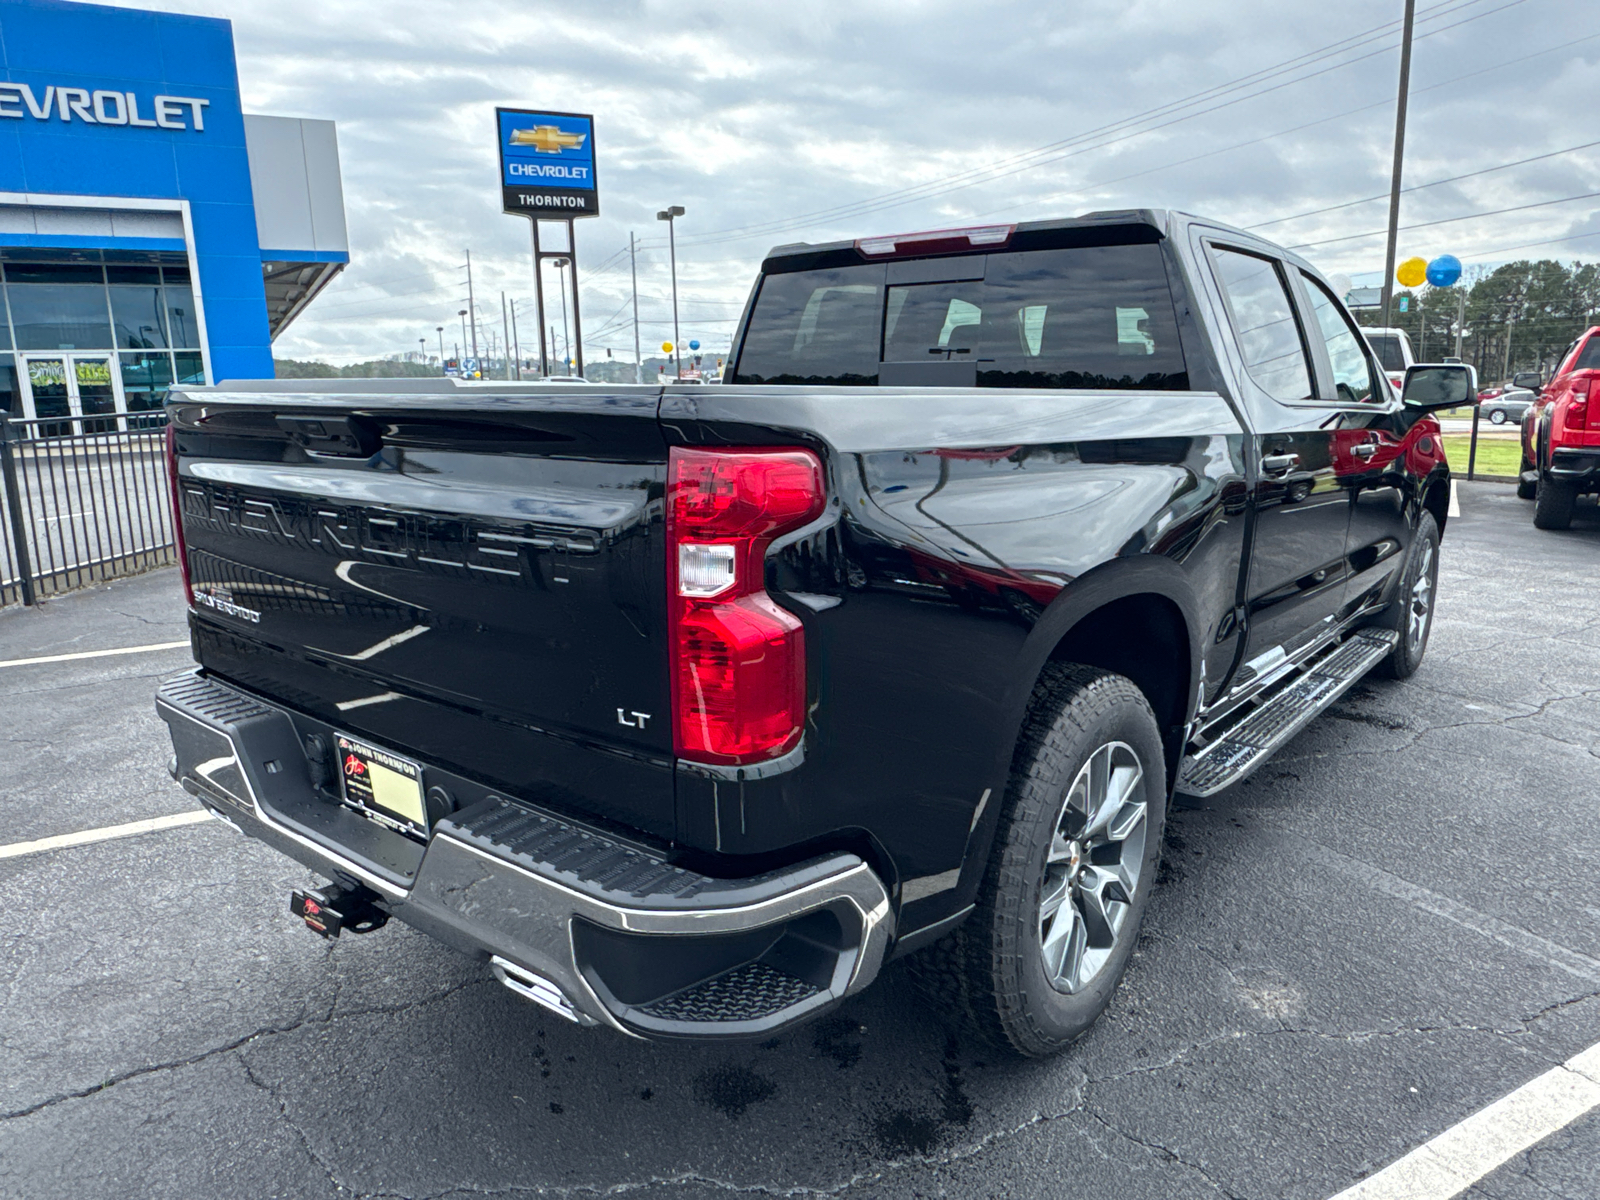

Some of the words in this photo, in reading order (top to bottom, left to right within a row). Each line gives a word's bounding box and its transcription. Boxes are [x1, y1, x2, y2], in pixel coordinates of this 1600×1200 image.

[509, 163, 588, 179] CHEVROLET
[518, 194, 585, 207] THORNTON
[194, 590, 261, 623] SILVERADO
[617, 708, 651, 729] LT
[353, 742, 373, 759] JOHN
[372, 750, 416, 777] THORNTON
